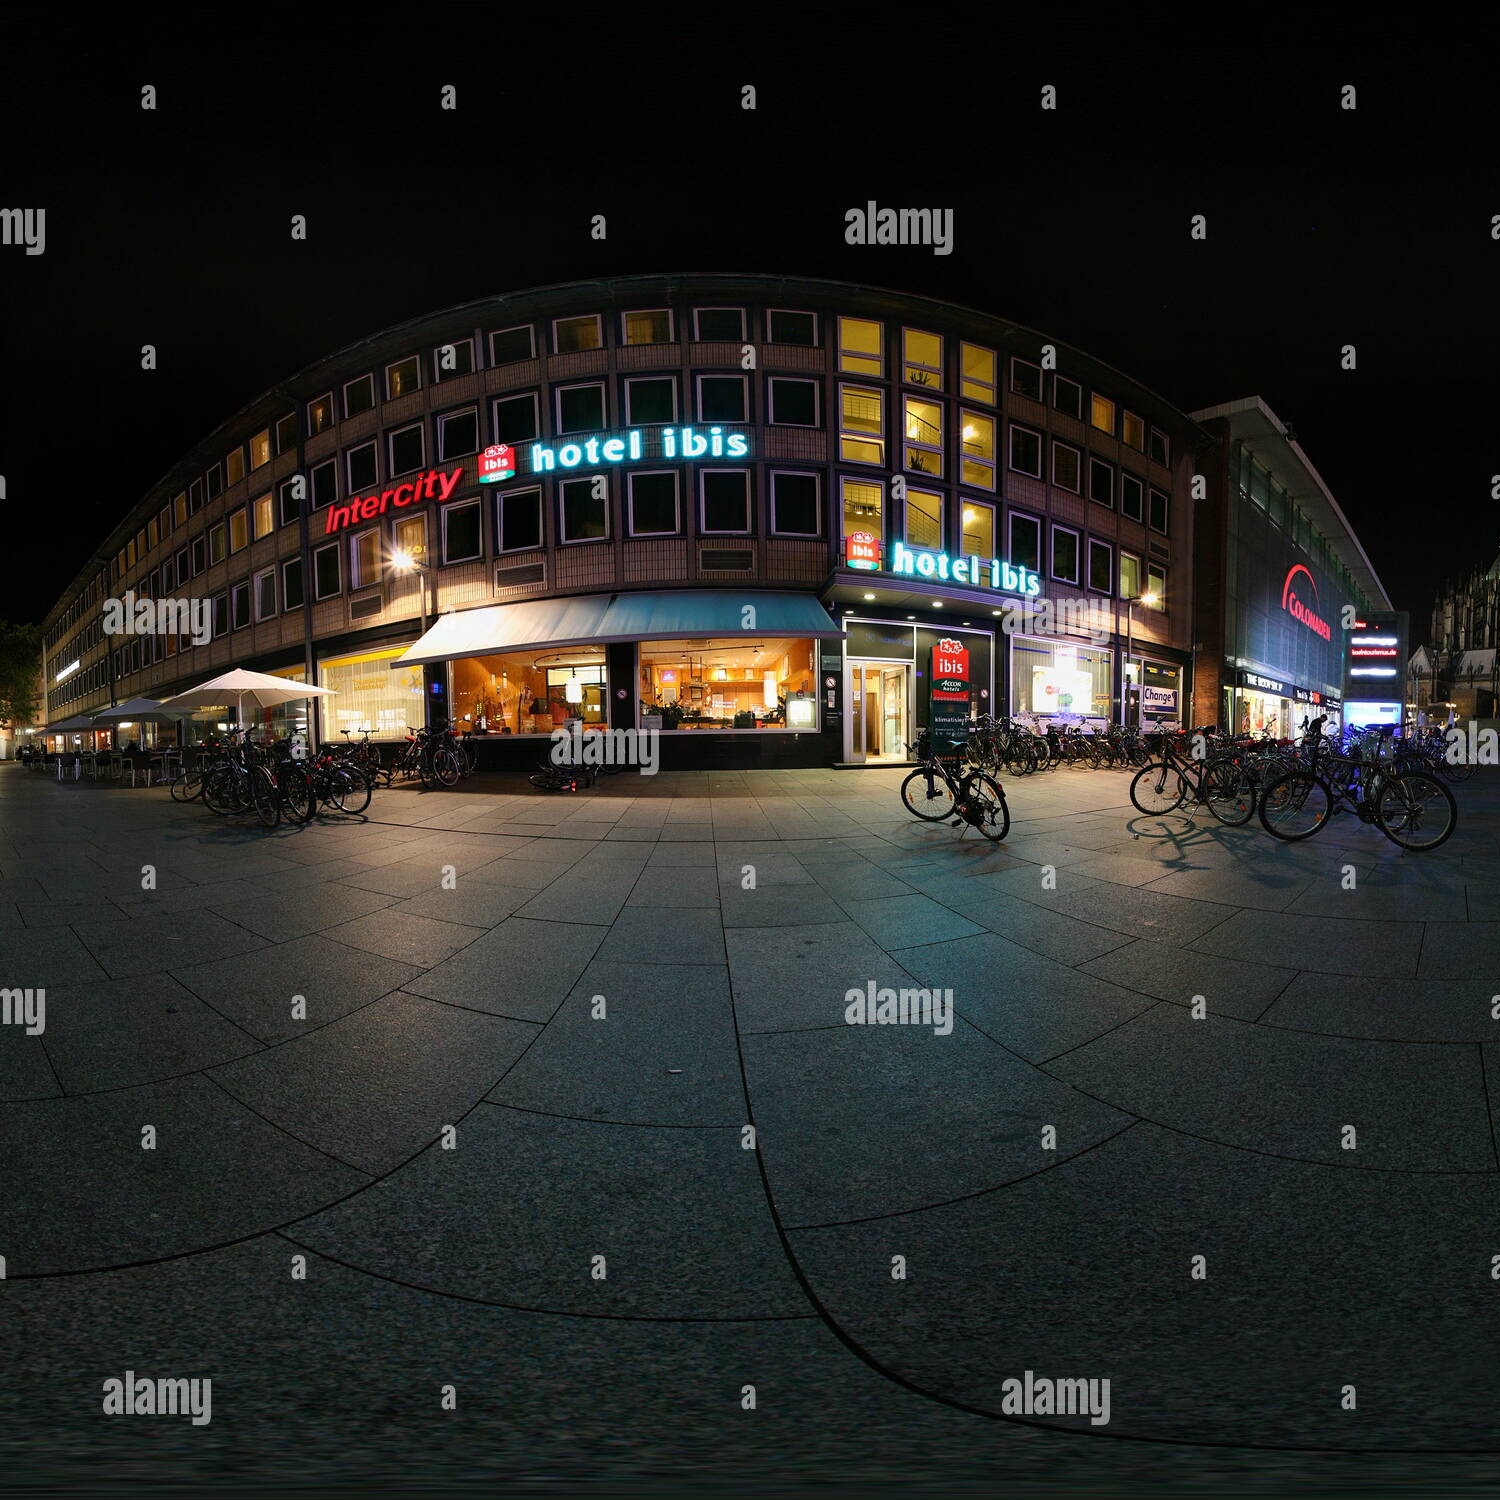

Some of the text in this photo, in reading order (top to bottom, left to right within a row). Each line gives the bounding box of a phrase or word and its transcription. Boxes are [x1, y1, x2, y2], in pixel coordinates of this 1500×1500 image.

[532, 426, 749, 472] hotel ibis
[485, 457, 508, 471] ibis
[325, 467, 464, 535] Intercity
[852, 544, 873, 557] ibis
[893, 541, 1041, 597] hotel ibis
[939, 658, 963, 674] ibis
[1246, 673, 1258, 686] THE
[1271, 680, 1283, 692] SHP
[1144, 687, 1172, 705] Change
